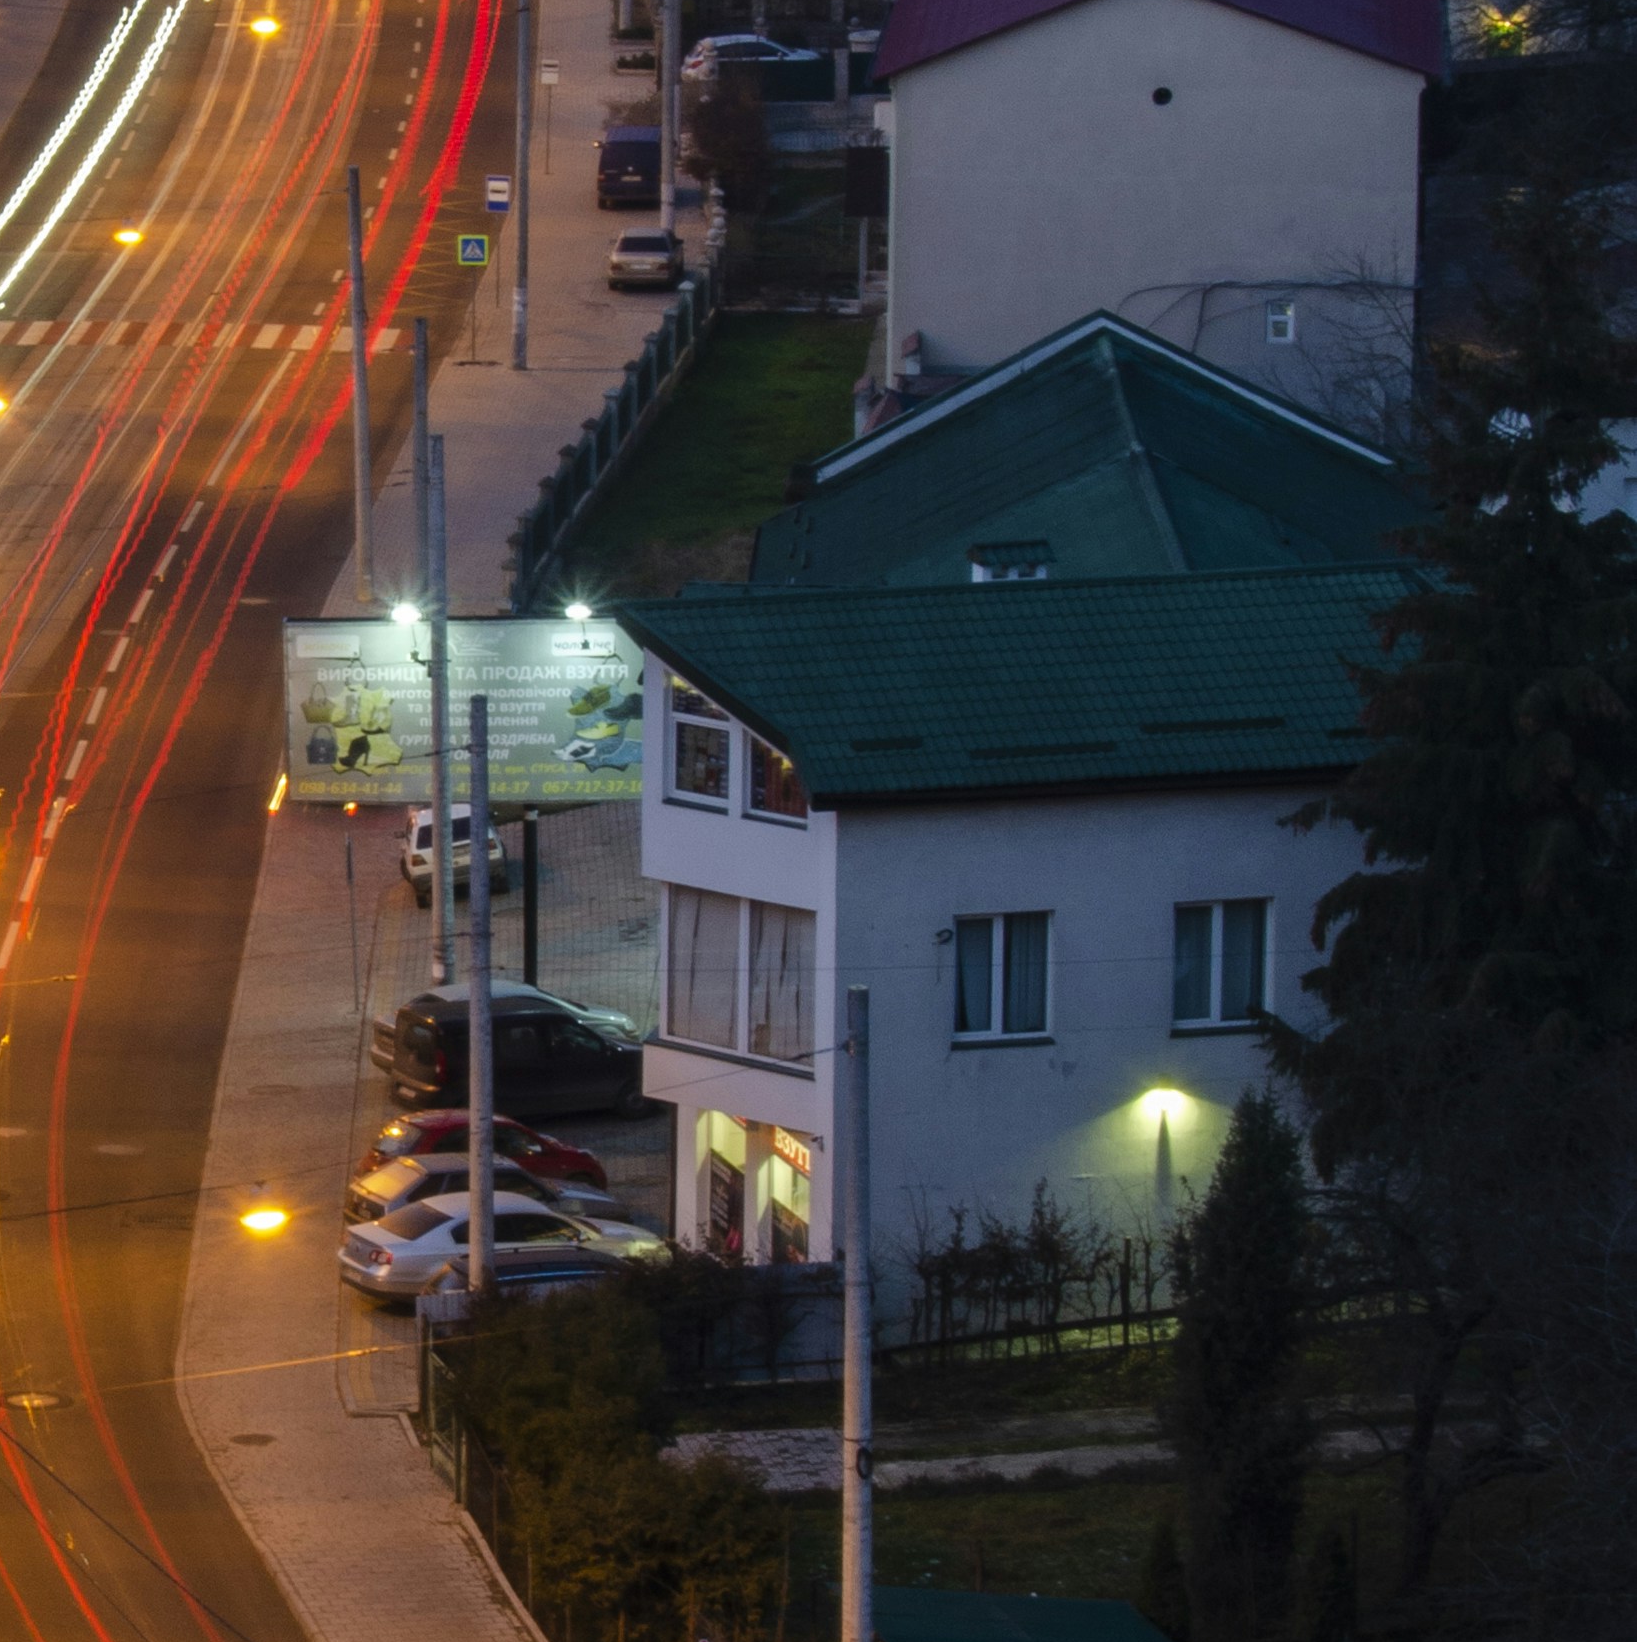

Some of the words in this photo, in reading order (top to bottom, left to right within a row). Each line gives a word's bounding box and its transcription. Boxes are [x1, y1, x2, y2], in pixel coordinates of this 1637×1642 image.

[455, 666, 478, 680] ТА
[482, 665, 560, 683] ПРОДАЖ
[566, 664, 629, 680] ВЗУТТЯ
[488, 686, 571, 698] чоловічого
[408, 703, 424, 713] та
[500, 703, 546, 715] взуття
[542, 780, 642, 794] 067-717-37-1
